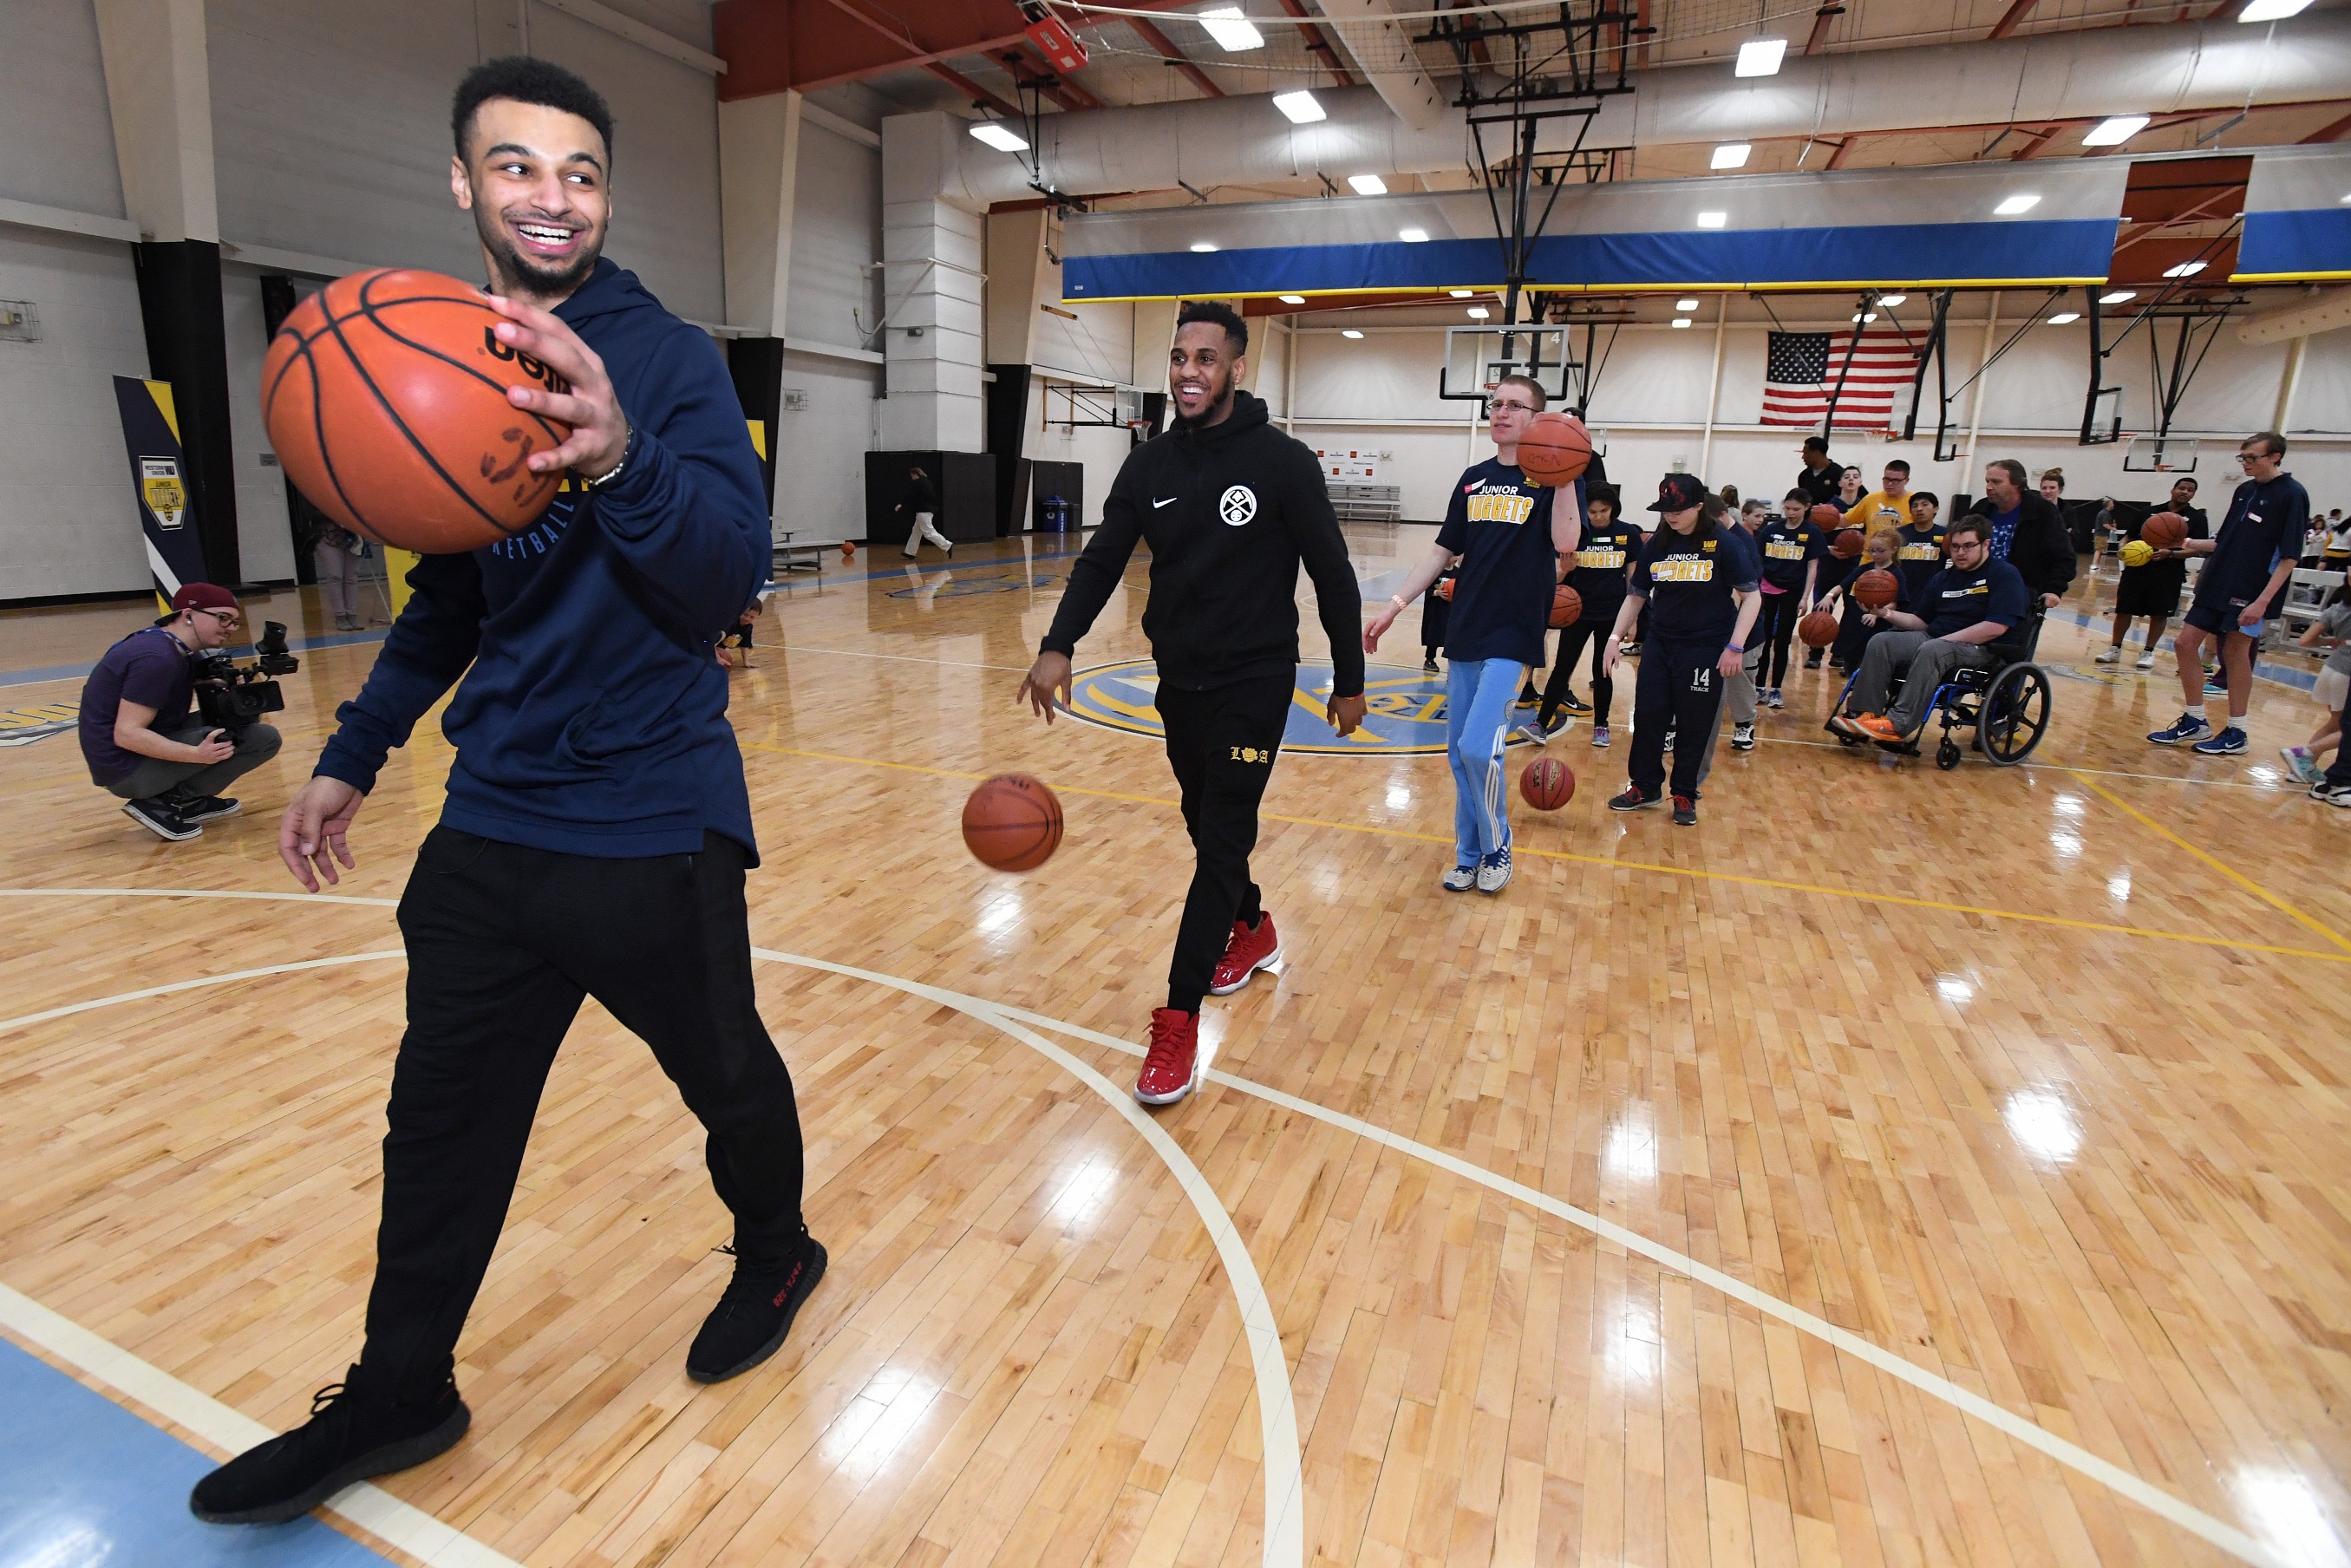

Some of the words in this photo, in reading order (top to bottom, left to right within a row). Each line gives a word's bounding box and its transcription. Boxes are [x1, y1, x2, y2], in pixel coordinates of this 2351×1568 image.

[1551, 332, 1560, 344] 4
[1479, 485, 1518, 495] JUNIOR
[1467, 493, 1534, 525] NUGGETS
[493, 500, 574, 559] KETBALL
[1765, 542, 1805, 560] NUGGETS
[1693, 667, 1710, 687] 14
